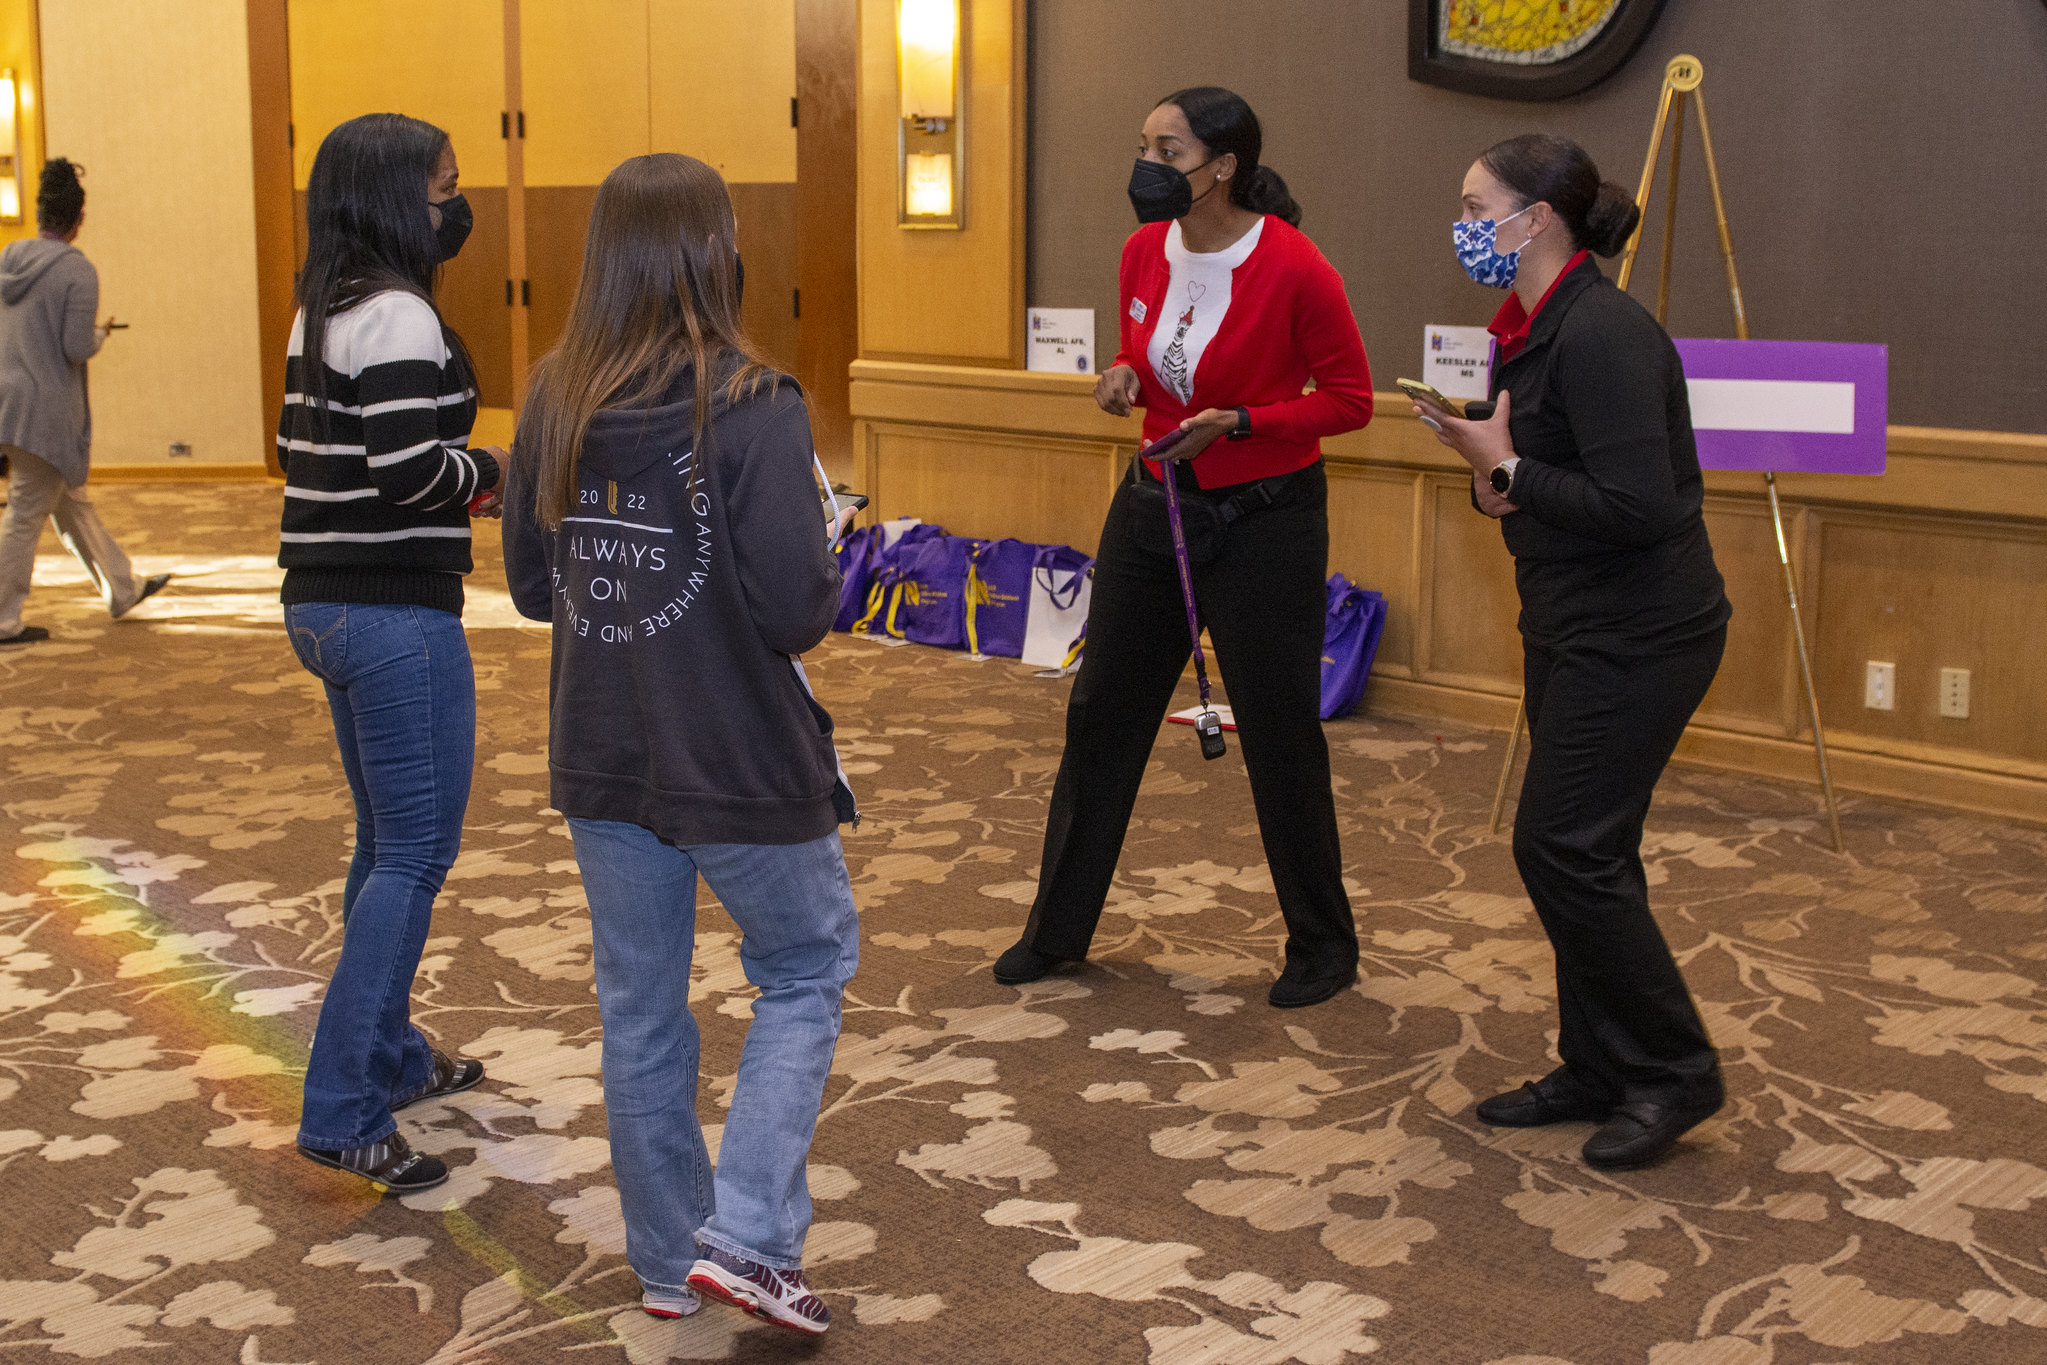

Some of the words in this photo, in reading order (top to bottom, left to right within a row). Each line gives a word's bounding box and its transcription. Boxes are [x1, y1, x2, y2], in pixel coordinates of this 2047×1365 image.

[1035, 337, 1069, 345] MAXWELL
[1435, 357, 1477, 366] KEESLER
[1461, 369, 1475, 377] MS
[580, 489, 599, 504] 20
[627, 494, 646, 510] 22
[569, 536, 666, 571] ALWAYS
[639, 522, 712, 637] ANYWHERE
[590, 577, 628, 603] ON
[600, 624, 634, 643] AND
